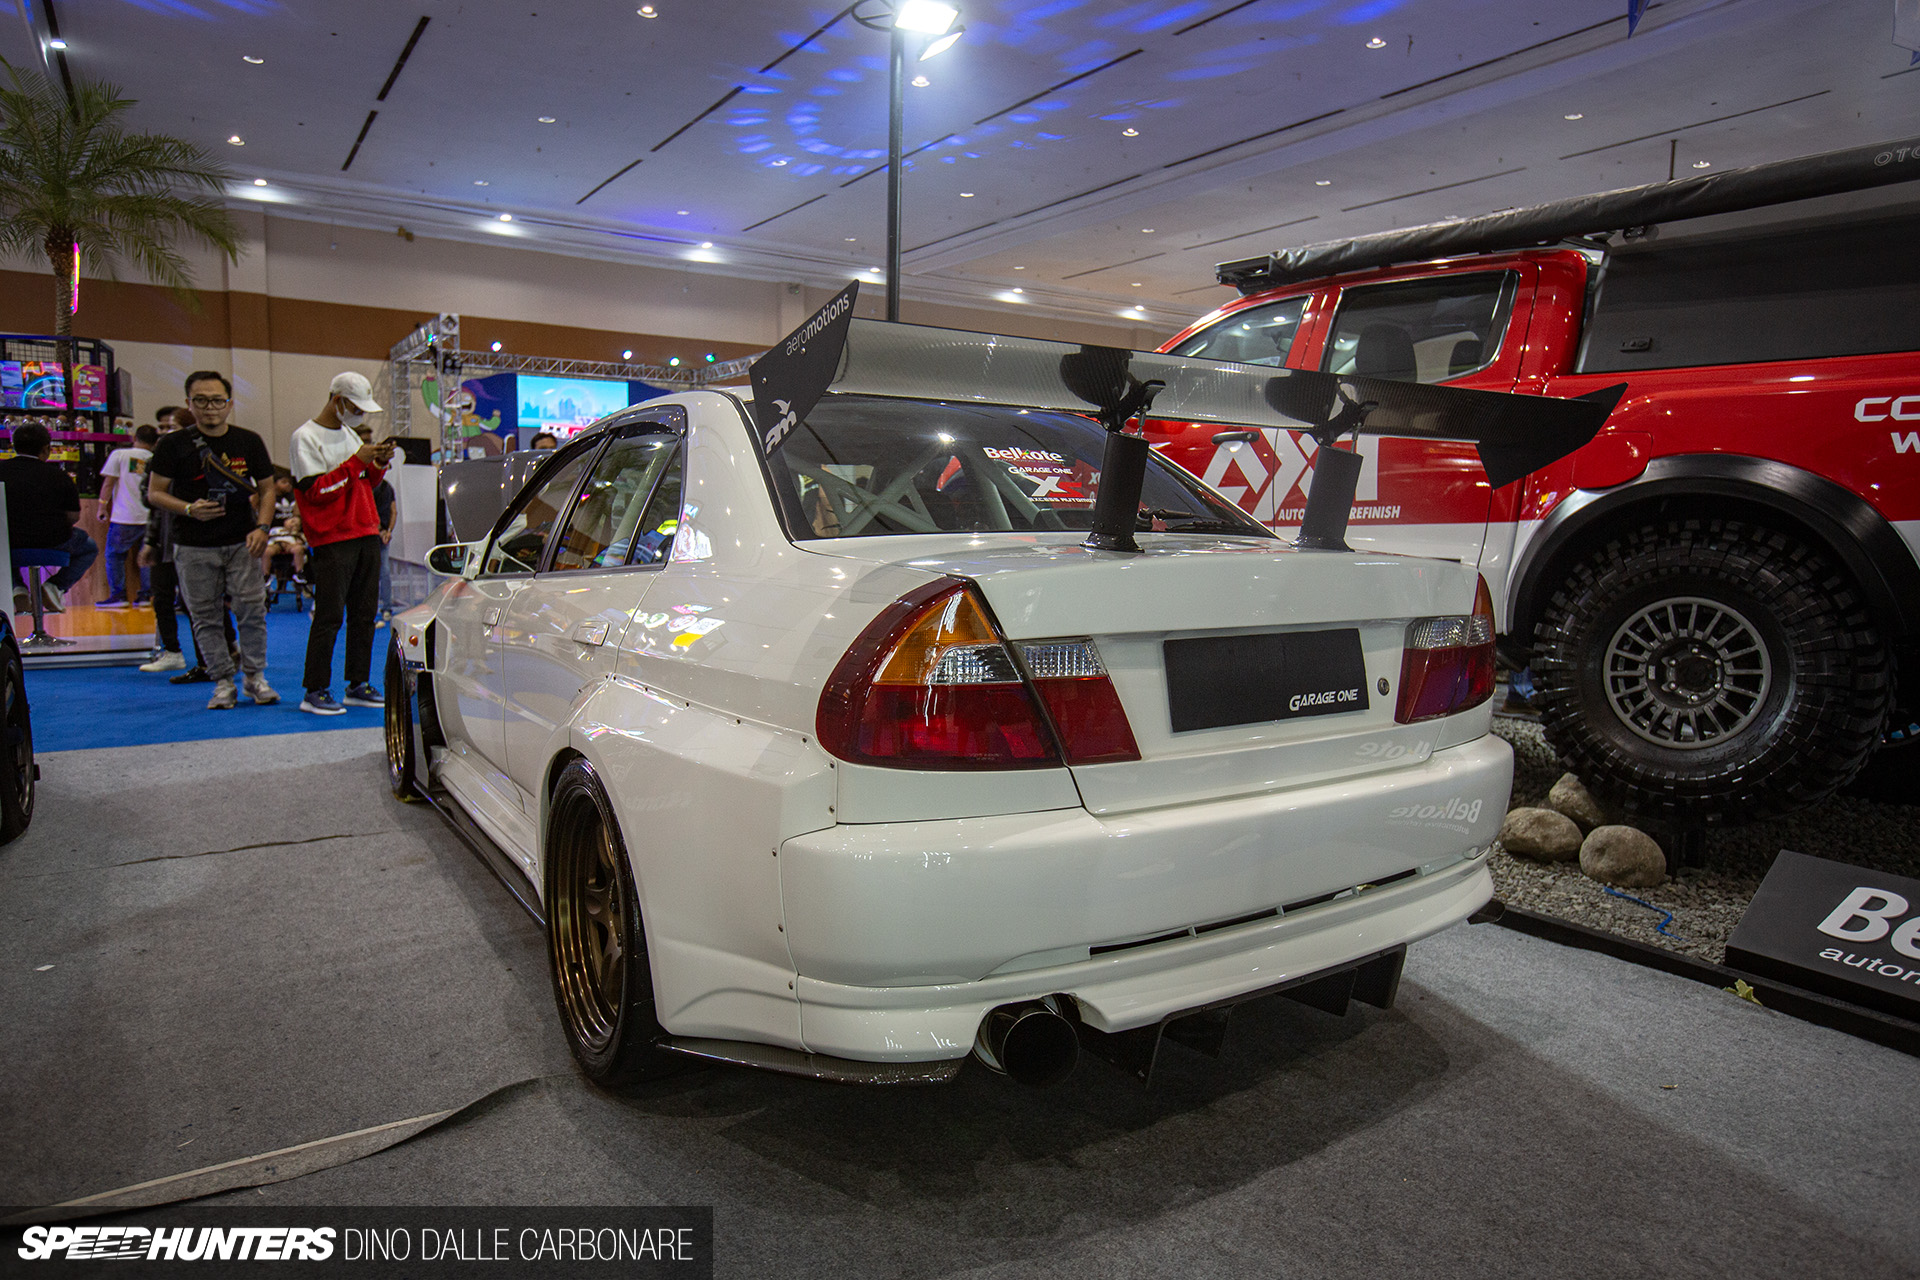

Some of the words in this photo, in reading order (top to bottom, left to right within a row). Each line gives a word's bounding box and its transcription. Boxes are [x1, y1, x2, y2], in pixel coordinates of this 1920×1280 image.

[786, 293, 850, 356] aeromotions
[983, 447, 1066, 462] Belkote
[1052, 467, 1074, 475] ONE
[1348, 505, 1401, 520] REFINISH
[1289, 691, 1336, 711] GARAGE
[1337, 688, 1359, 702] ONE
